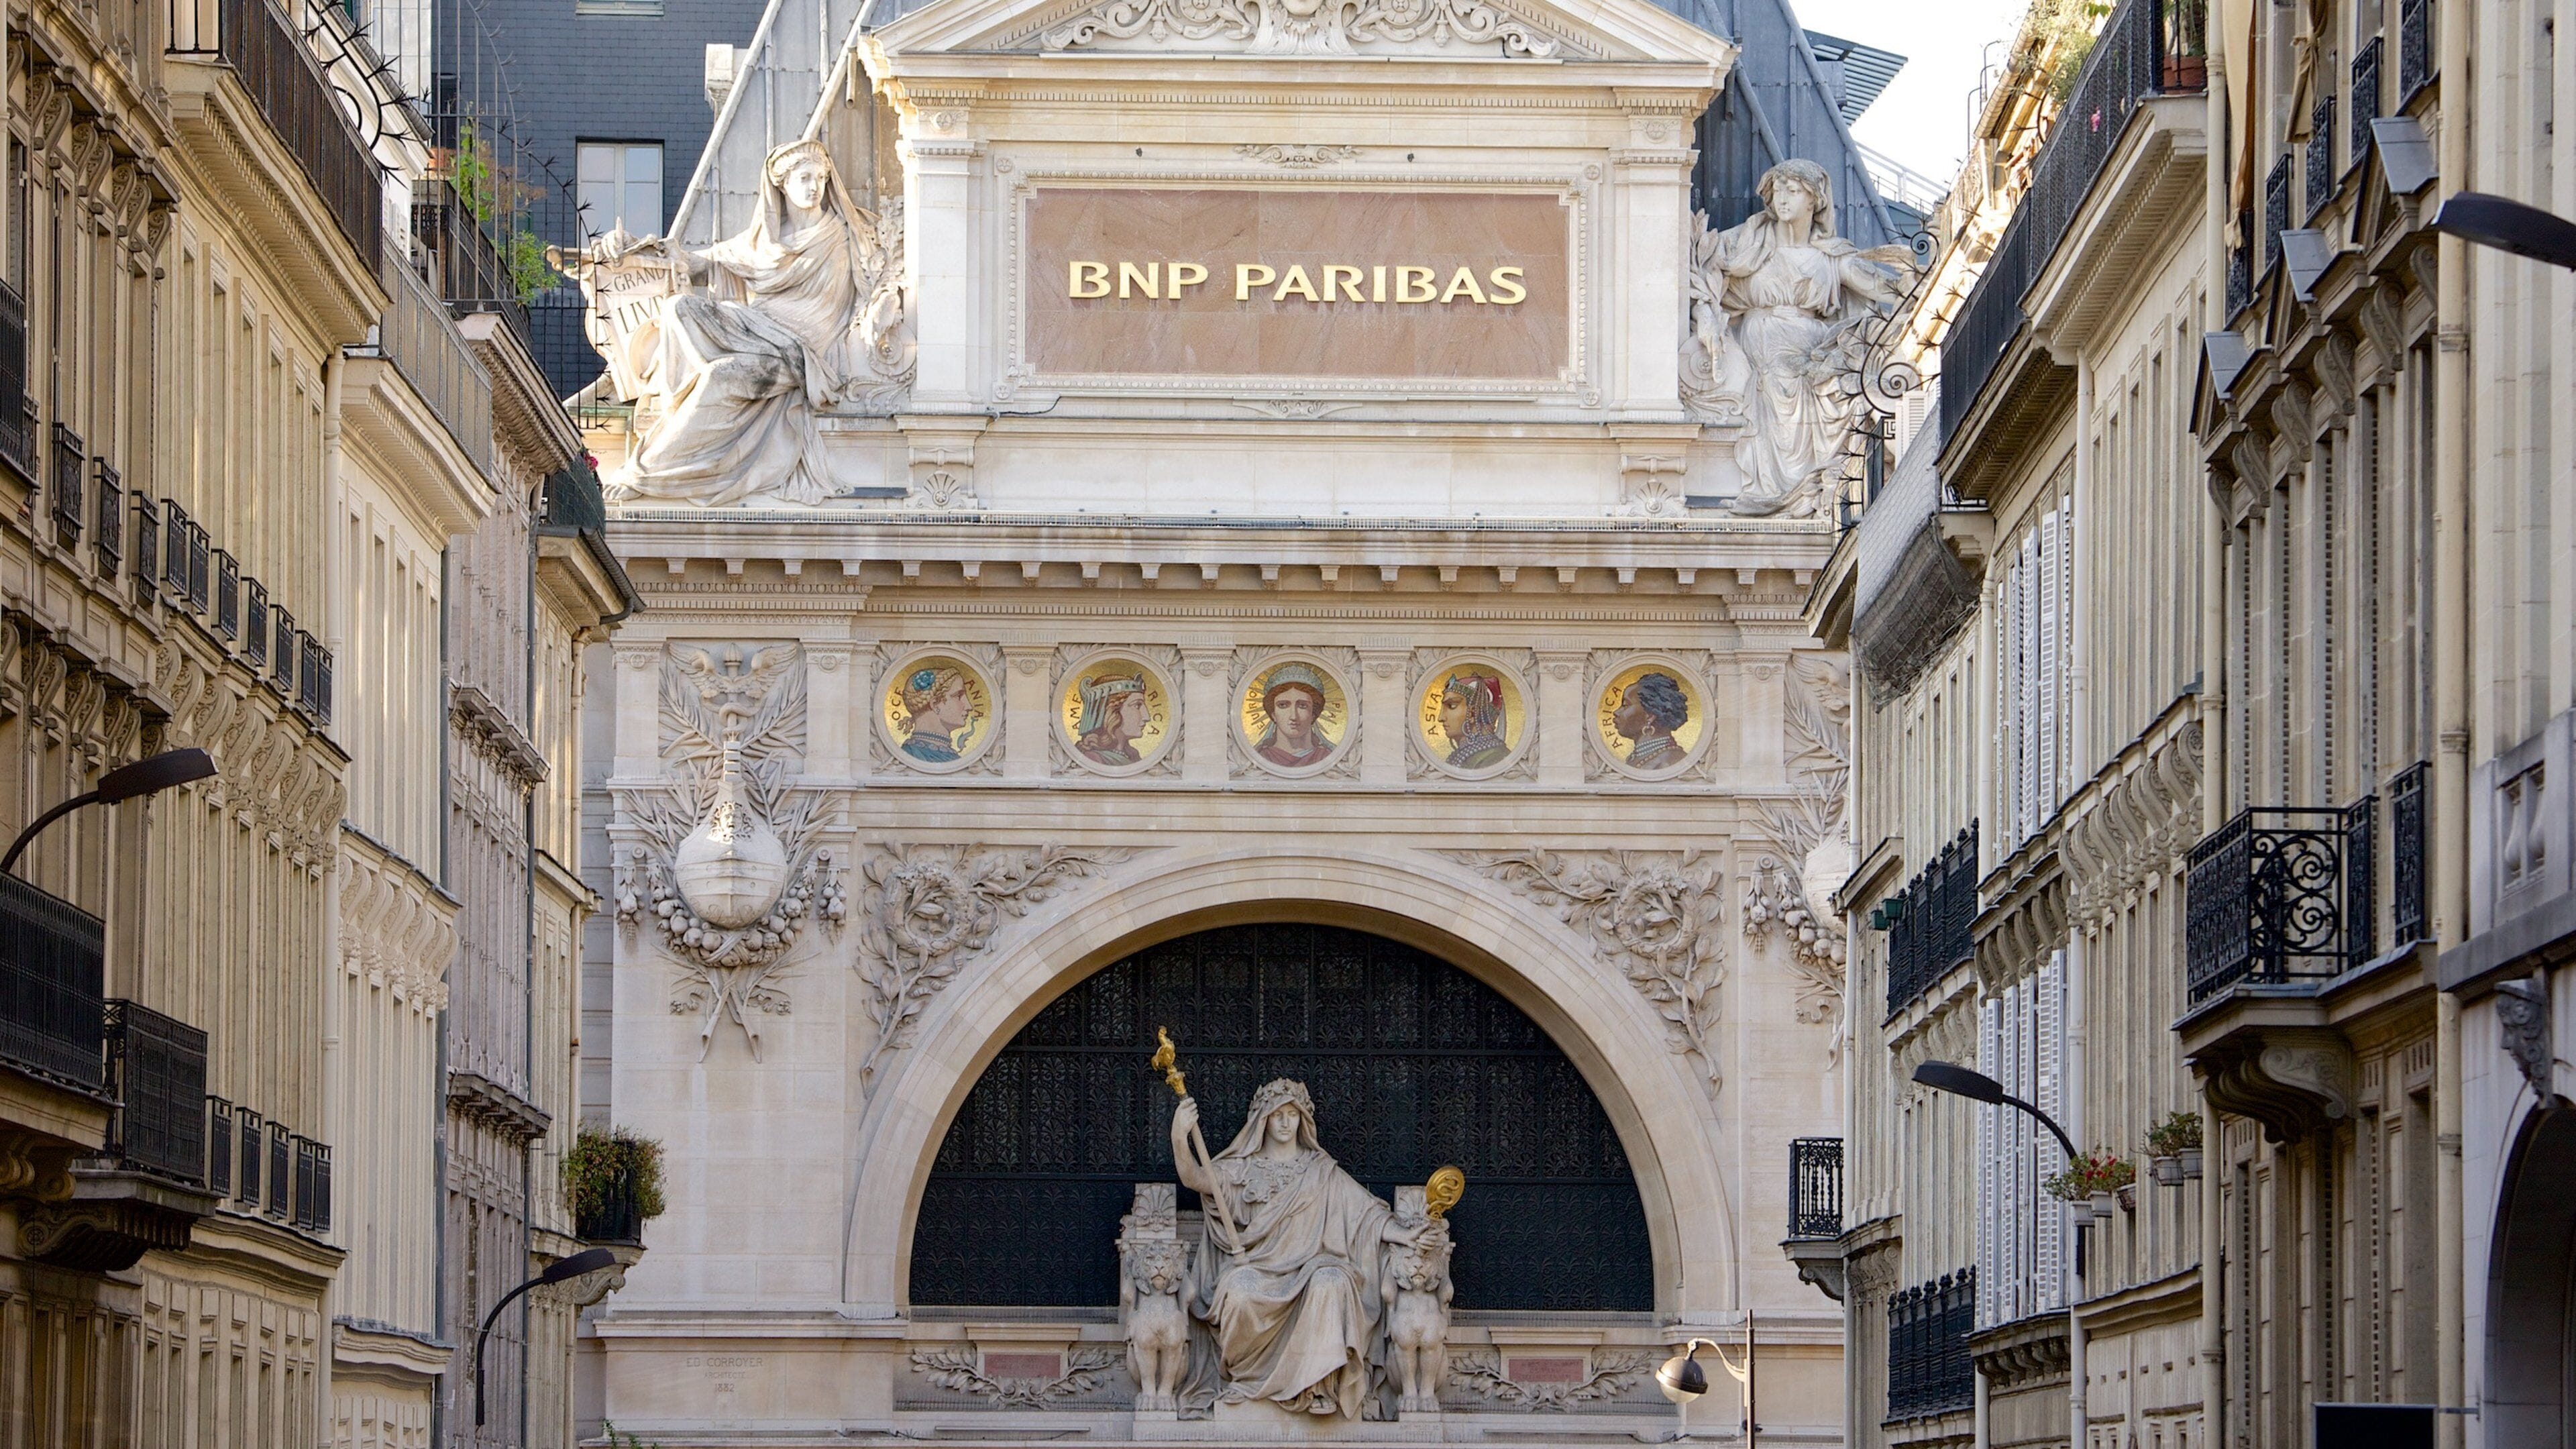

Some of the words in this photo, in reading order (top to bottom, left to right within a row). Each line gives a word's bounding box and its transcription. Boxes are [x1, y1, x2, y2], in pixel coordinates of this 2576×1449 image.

[614, 268, 665, 292] GRAND
[1069, 260, 1208, 299] BNP
[1236, 264, 1527, 305] PARIBAS
[1426, 693, 1442, 735] ASIA
[1603, 686, 1622, 749] AFRICA
[706, 1357, 763, 1367] CORROYER
[714, 1383, 735, 1393] 1882
